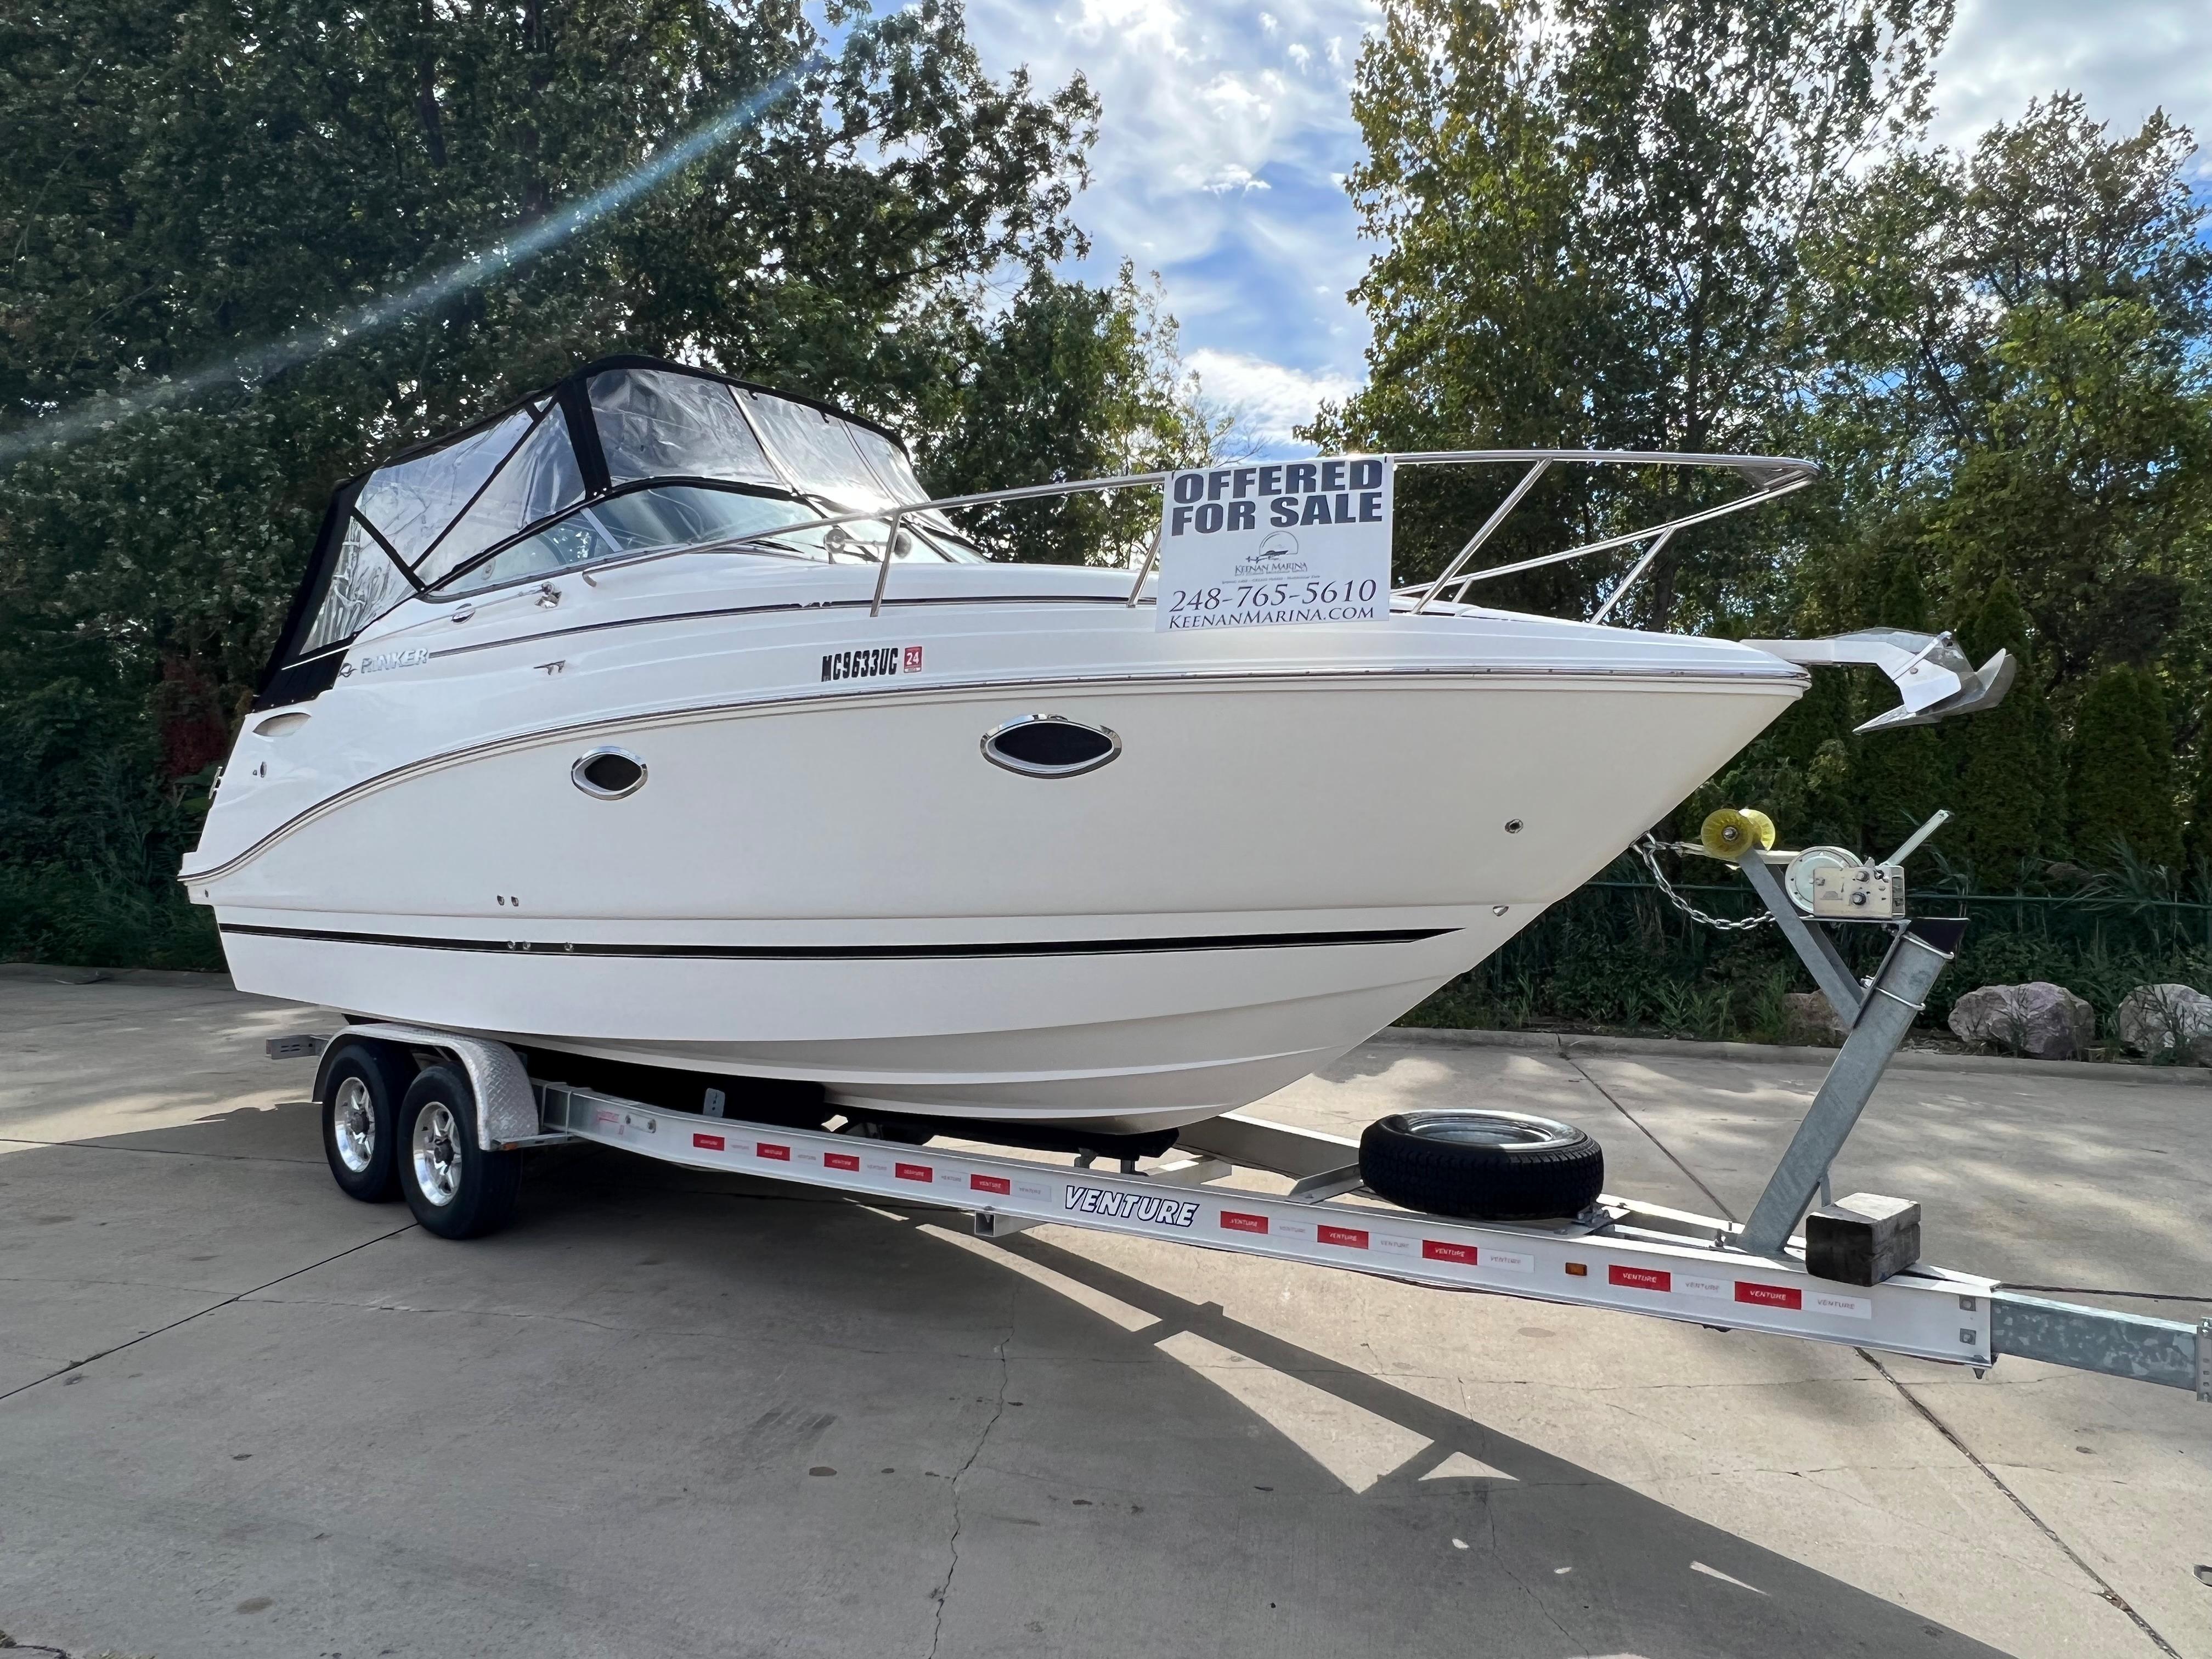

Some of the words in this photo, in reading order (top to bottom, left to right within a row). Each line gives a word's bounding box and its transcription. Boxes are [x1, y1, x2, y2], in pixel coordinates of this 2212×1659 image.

[1174, 460, 1383, 504] OFFERED
[1171, 500, 1256, 537] FOR
[1270, 492, 1383, 528] SALE
[1169, 579, 1377, 613] 248-765-5610
[1169, 606, 1374, 629] KEENANMARINA.COM
[361, 647, 428, 674] RINKER
[906, 651, 919, 665] 24
[821, 647, 899, 682] MC9633UC
[1065, 1184, 1200, 1228] VENTURE
[1230, 1218, 1258, 1227] VENTURE
[1329, 1232, 1357, 1242] VENTURE
[1435, 1248, 1465, 1257] VENTURE
[1491, 1255, 1521, 1264] VENTURE
[1623, 1272, 1657, 1283] VENTURE
[1685, 1282, 1720, 1291] VENTURE
[1750, 1290, 1786, 1301] VENTURE
[1818, 1299, 1855, 1310] VENTURE
